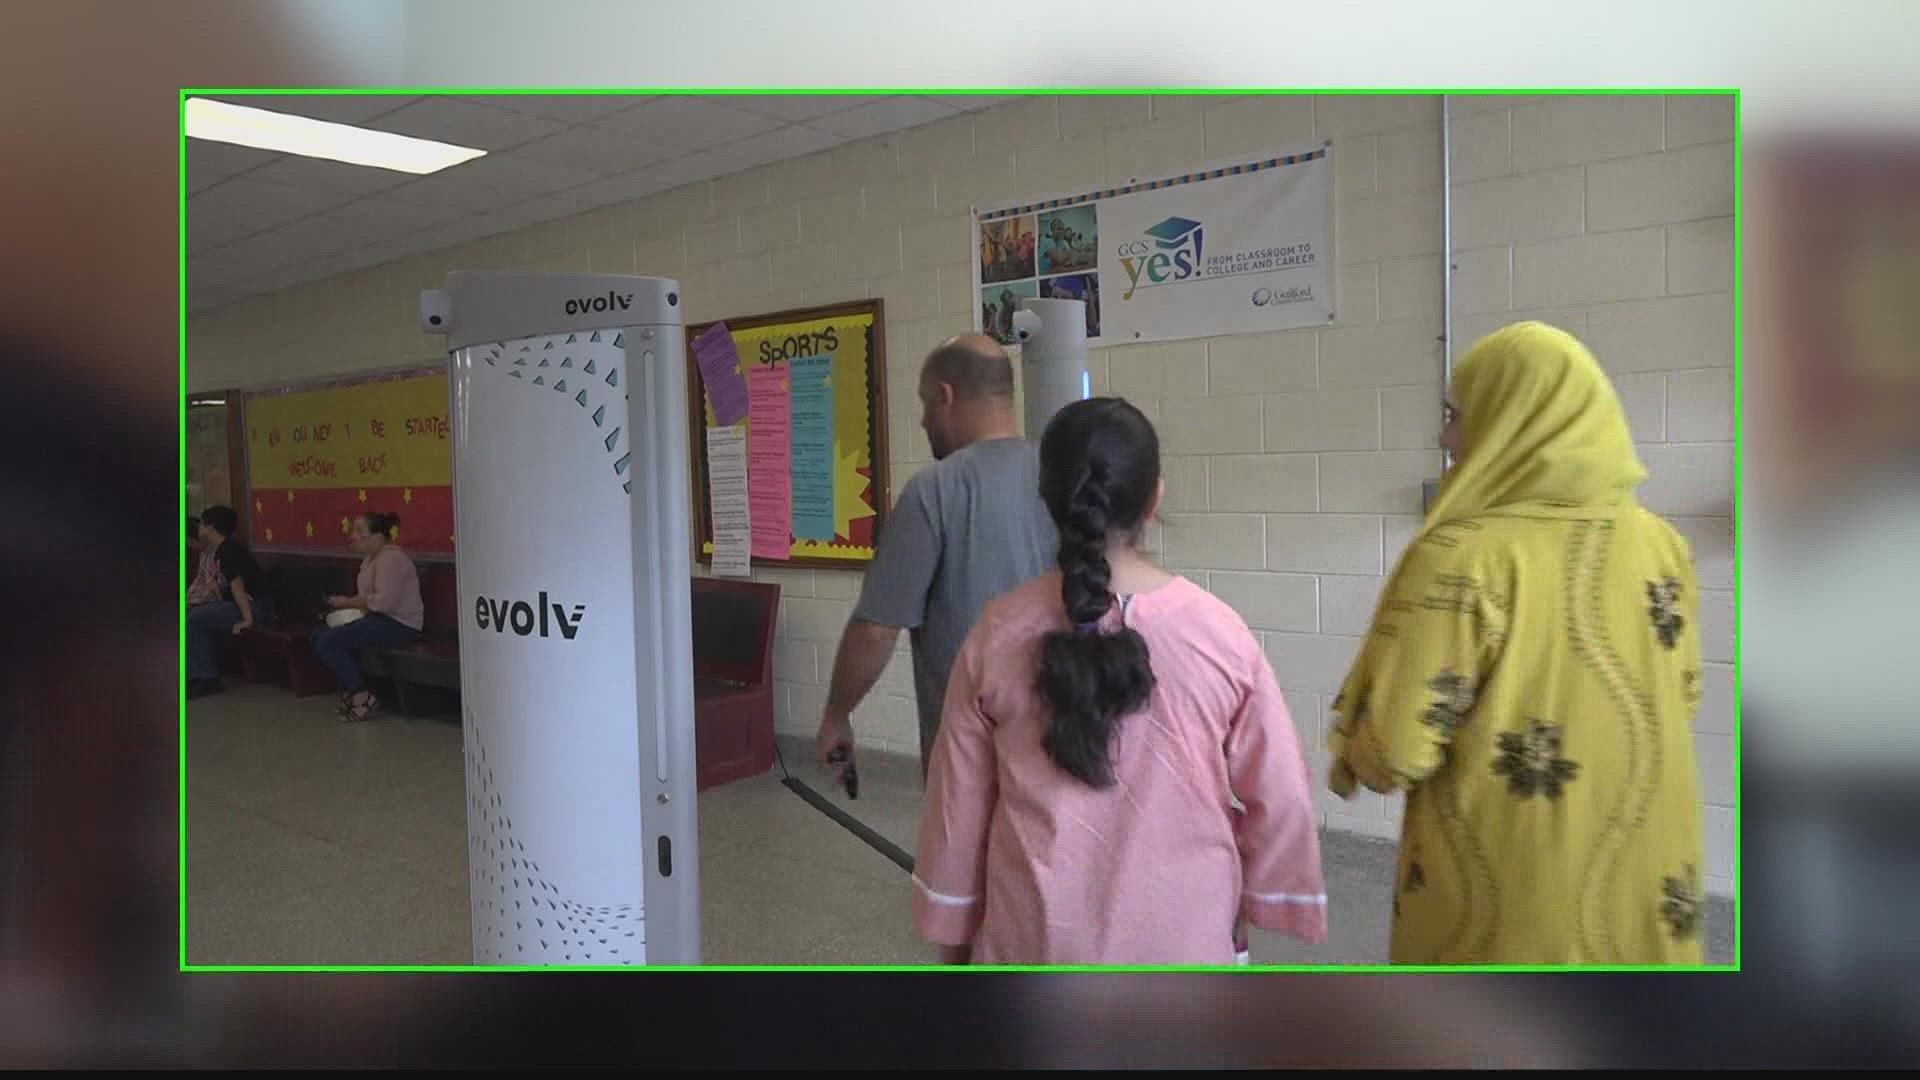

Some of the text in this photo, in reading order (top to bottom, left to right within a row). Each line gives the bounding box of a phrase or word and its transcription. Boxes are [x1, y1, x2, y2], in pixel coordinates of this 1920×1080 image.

[1118, 240, 1149, 257] GCS
[1207, 243, 1311, 266] FROM CLASSROOM TO
[1119, 227, 1204, 301] yes!
[1206, 253, 1316, 276] COLLEGE AND CAREER
[565, 290, 634, 316] evolv
[371, 419, 385, 438] BE
[288, 450, 387, 478] WELCOME BACK
[475, 590, 586, 641] evolv
